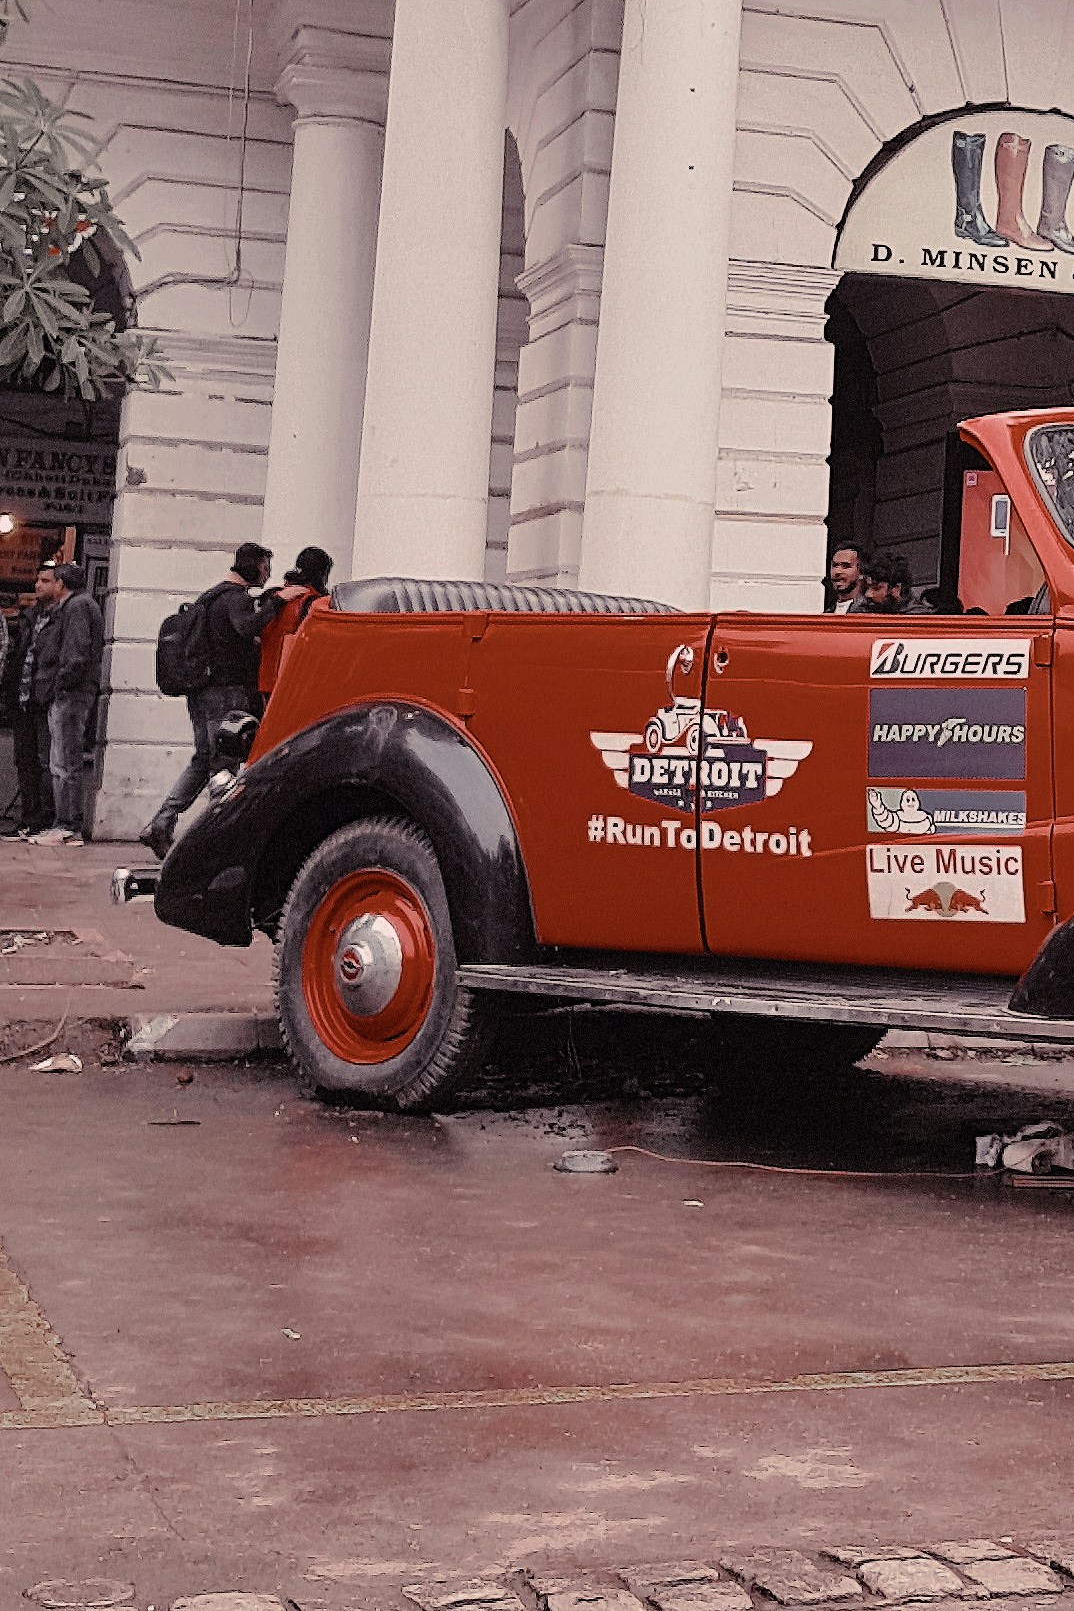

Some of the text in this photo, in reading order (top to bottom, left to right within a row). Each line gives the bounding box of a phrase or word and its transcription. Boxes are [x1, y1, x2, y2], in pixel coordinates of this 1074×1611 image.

[870, 243, 904, 265] D.
[921, 248, 1059, 279] MINSEN
[872, 642, 1026, 675] BURGERS
[872, 723, 1025, 745] HAPPY HOURS
[631, 757, 764, 789] DETROIT
[933, 809, 1027, 825] MILKSHAKES
[587, 814, 814, 857] #RunToDetroit
[869, 847, 1020, 876] Live Music
